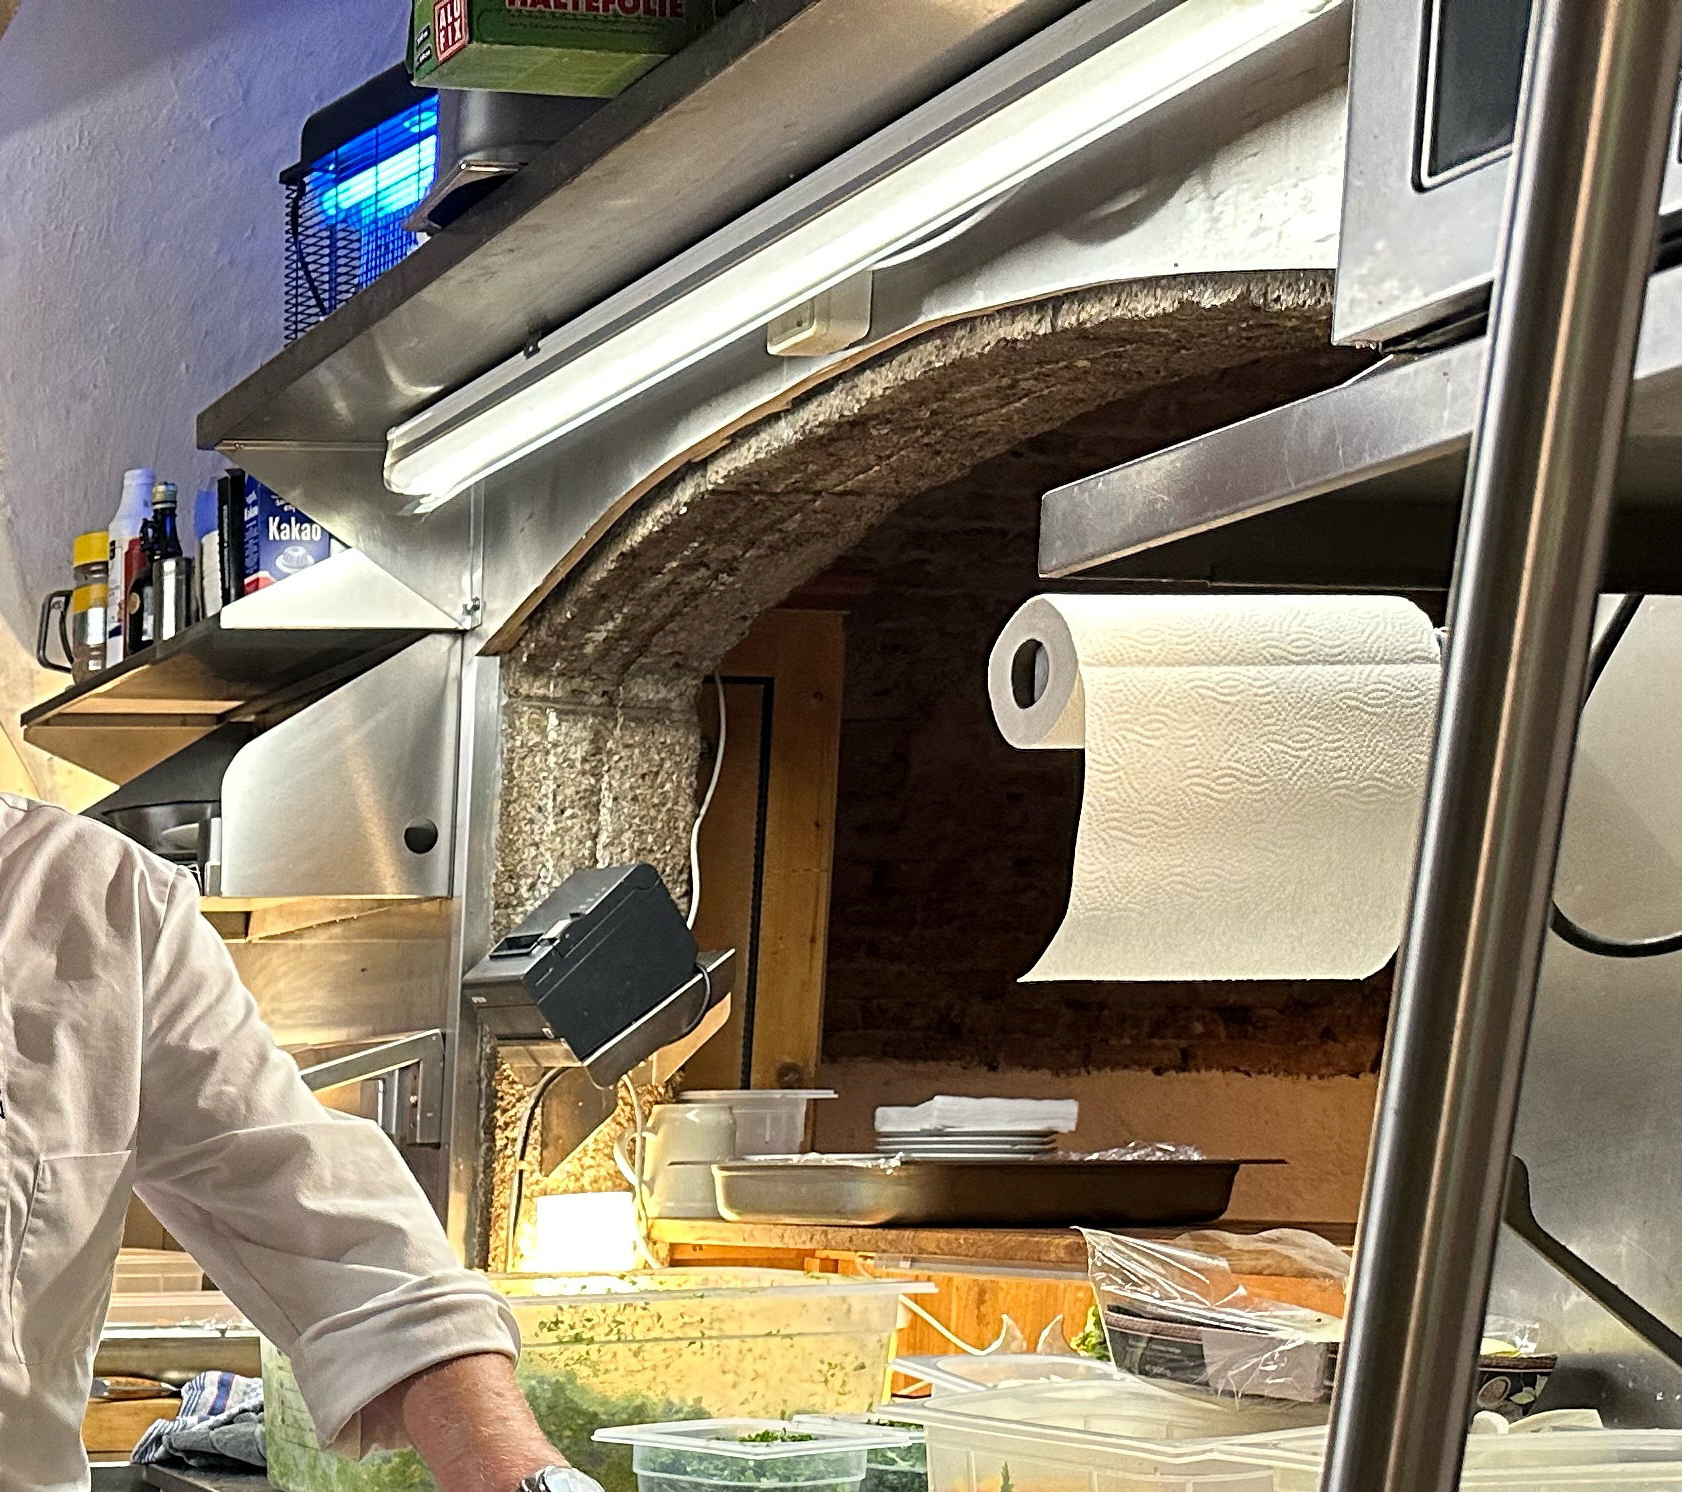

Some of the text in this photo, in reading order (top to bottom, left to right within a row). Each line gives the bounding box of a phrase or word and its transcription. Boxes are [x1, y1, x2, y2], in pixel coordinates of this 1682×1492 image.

[439, 0, 461, 29] ALU
[439, 18, 463, 52] FIX
[268, 516, 322, 541] Kakao
